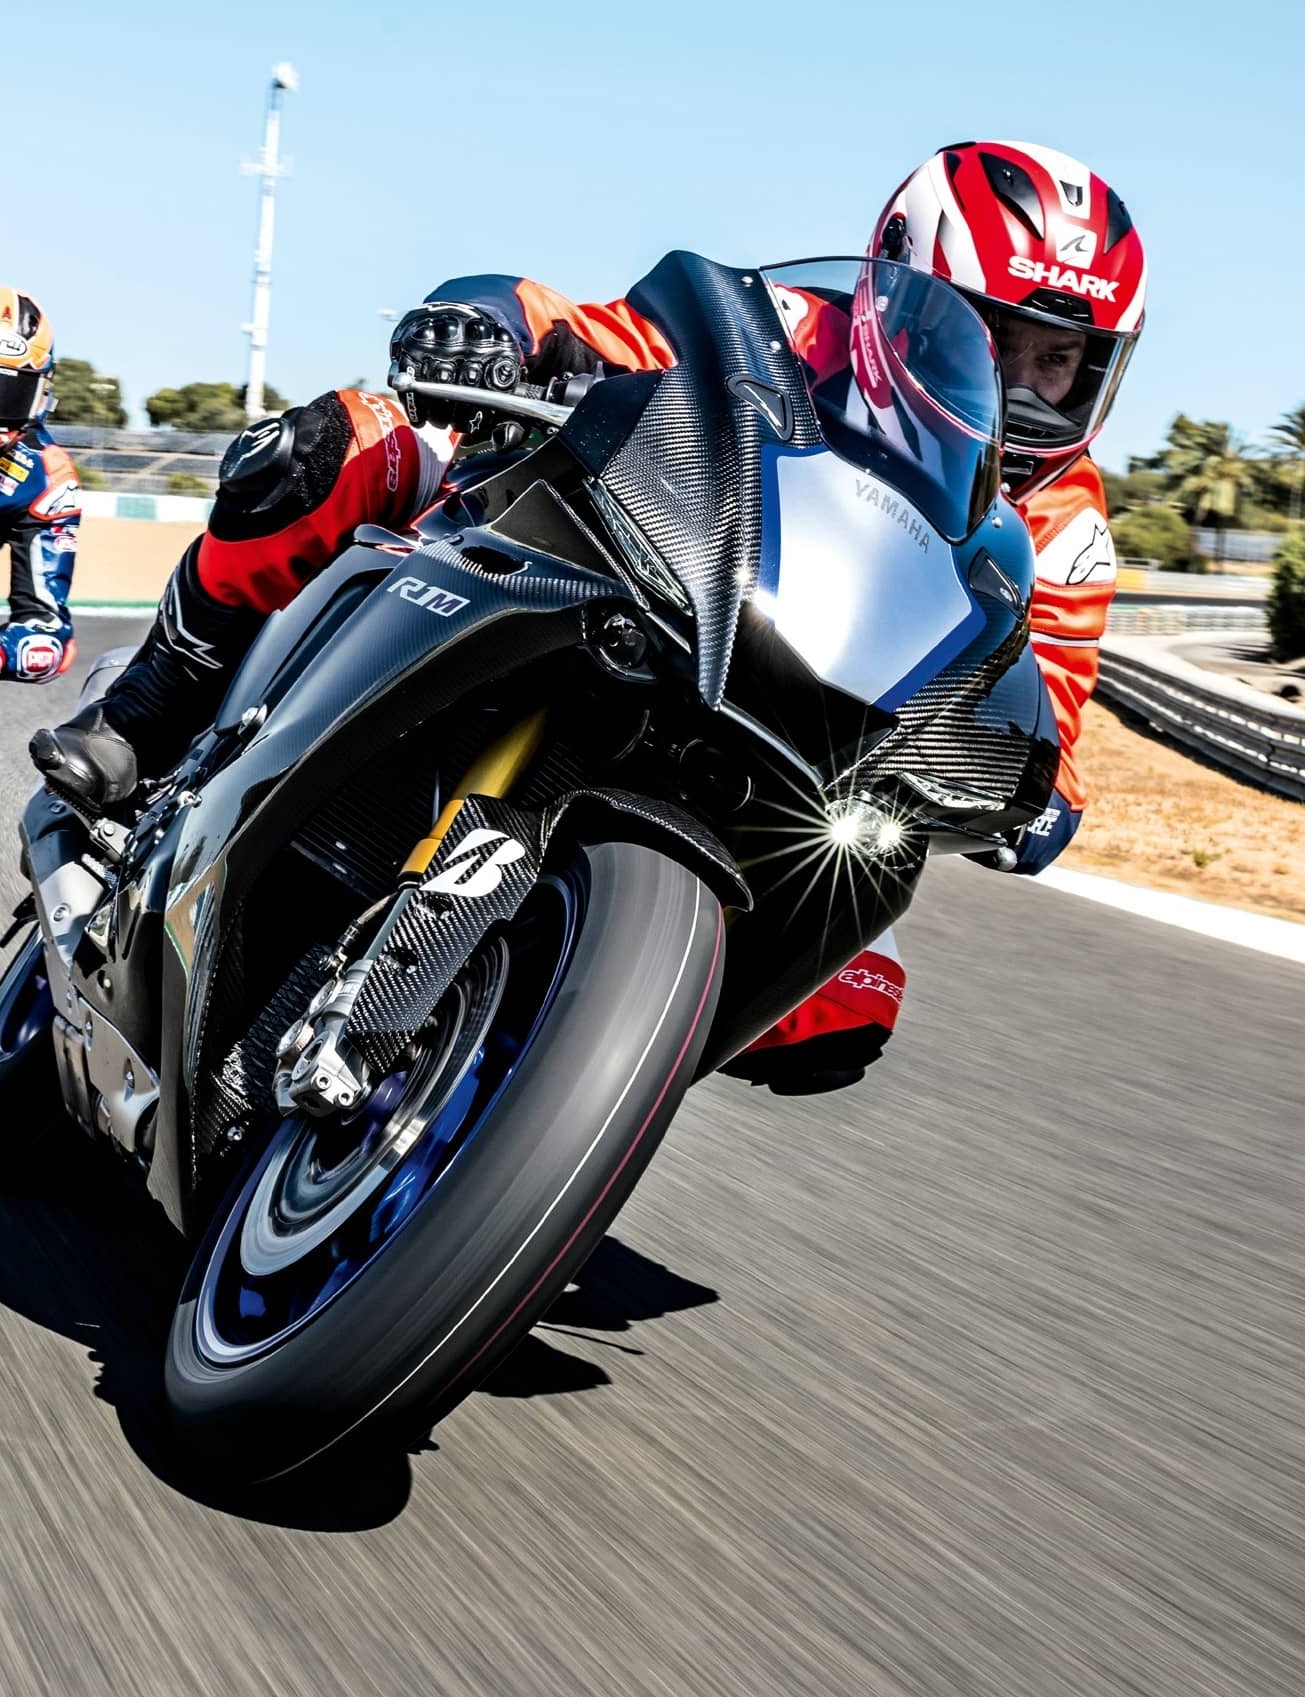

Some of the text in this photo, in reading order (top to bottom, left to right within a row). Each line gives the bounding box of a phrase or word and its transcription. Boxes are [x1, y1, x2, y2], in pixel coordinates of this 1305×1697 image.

[1008, 255, 1120, 302] SHARK
[856, 479, 930, 554] YAMAHA
[387, 576, 471, 617] R1M
